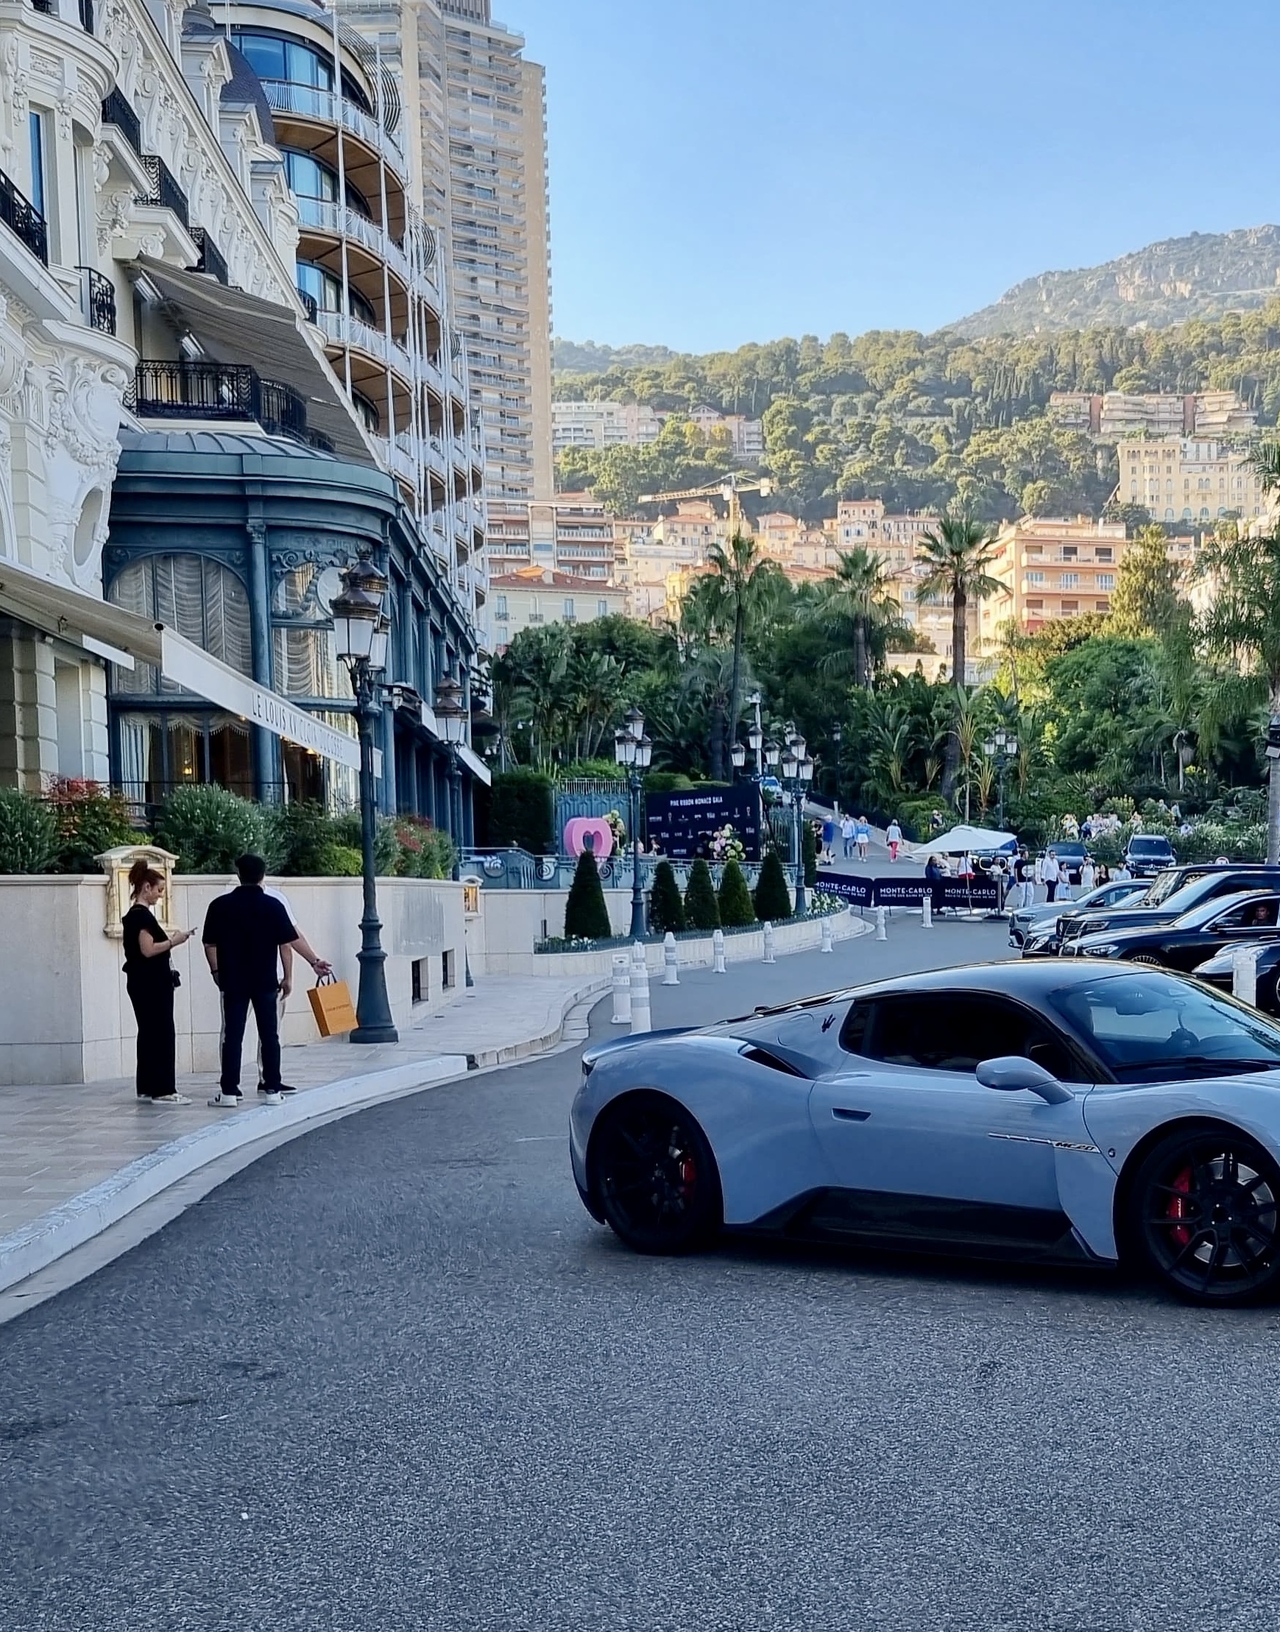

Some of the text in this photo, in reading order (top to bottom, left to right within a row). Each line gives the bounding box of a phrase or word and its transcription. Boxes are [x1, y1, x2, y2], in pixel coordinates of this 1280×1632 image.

[251, 691, 262, 719] LE
[265, 698, 287, 731] LOUIS
[1055, 1141, 1096, 1151] MC20
